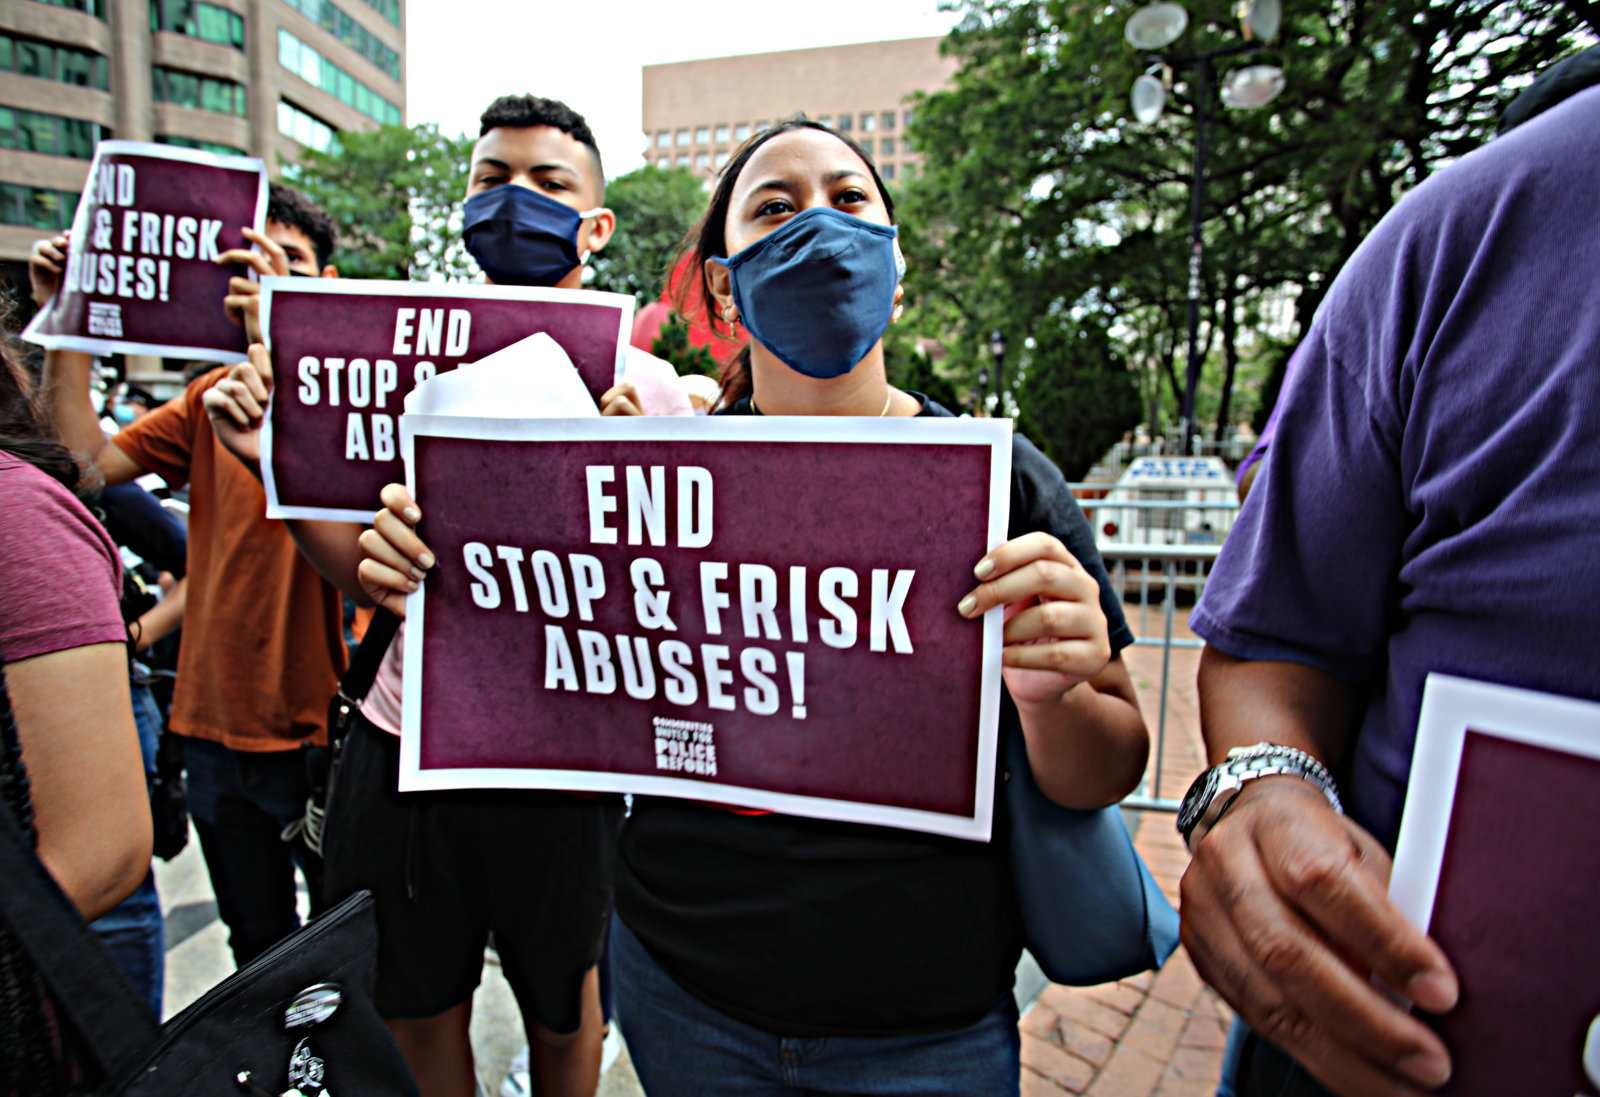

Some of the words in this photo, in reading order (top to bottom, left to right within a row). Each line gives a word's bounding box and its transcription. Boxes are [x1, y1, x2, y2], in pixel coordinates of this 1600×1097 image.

[93, 208, 113, 250] &
[122, 210, 223, 263] FRISK
[393, 308, 471, 357] END
[298, 356, 398, 408] STOP
[585, 465, 714, 548] END
[463, 541, 606, 621] STOP
[629, 557, 678, 631] &
[700, 561, 916, 654] FRISK
[544, 624, 807, 719] ABUSES!
[655, 738, 716, 761] POLICE
[656, 754, 718, 777] REFORM
